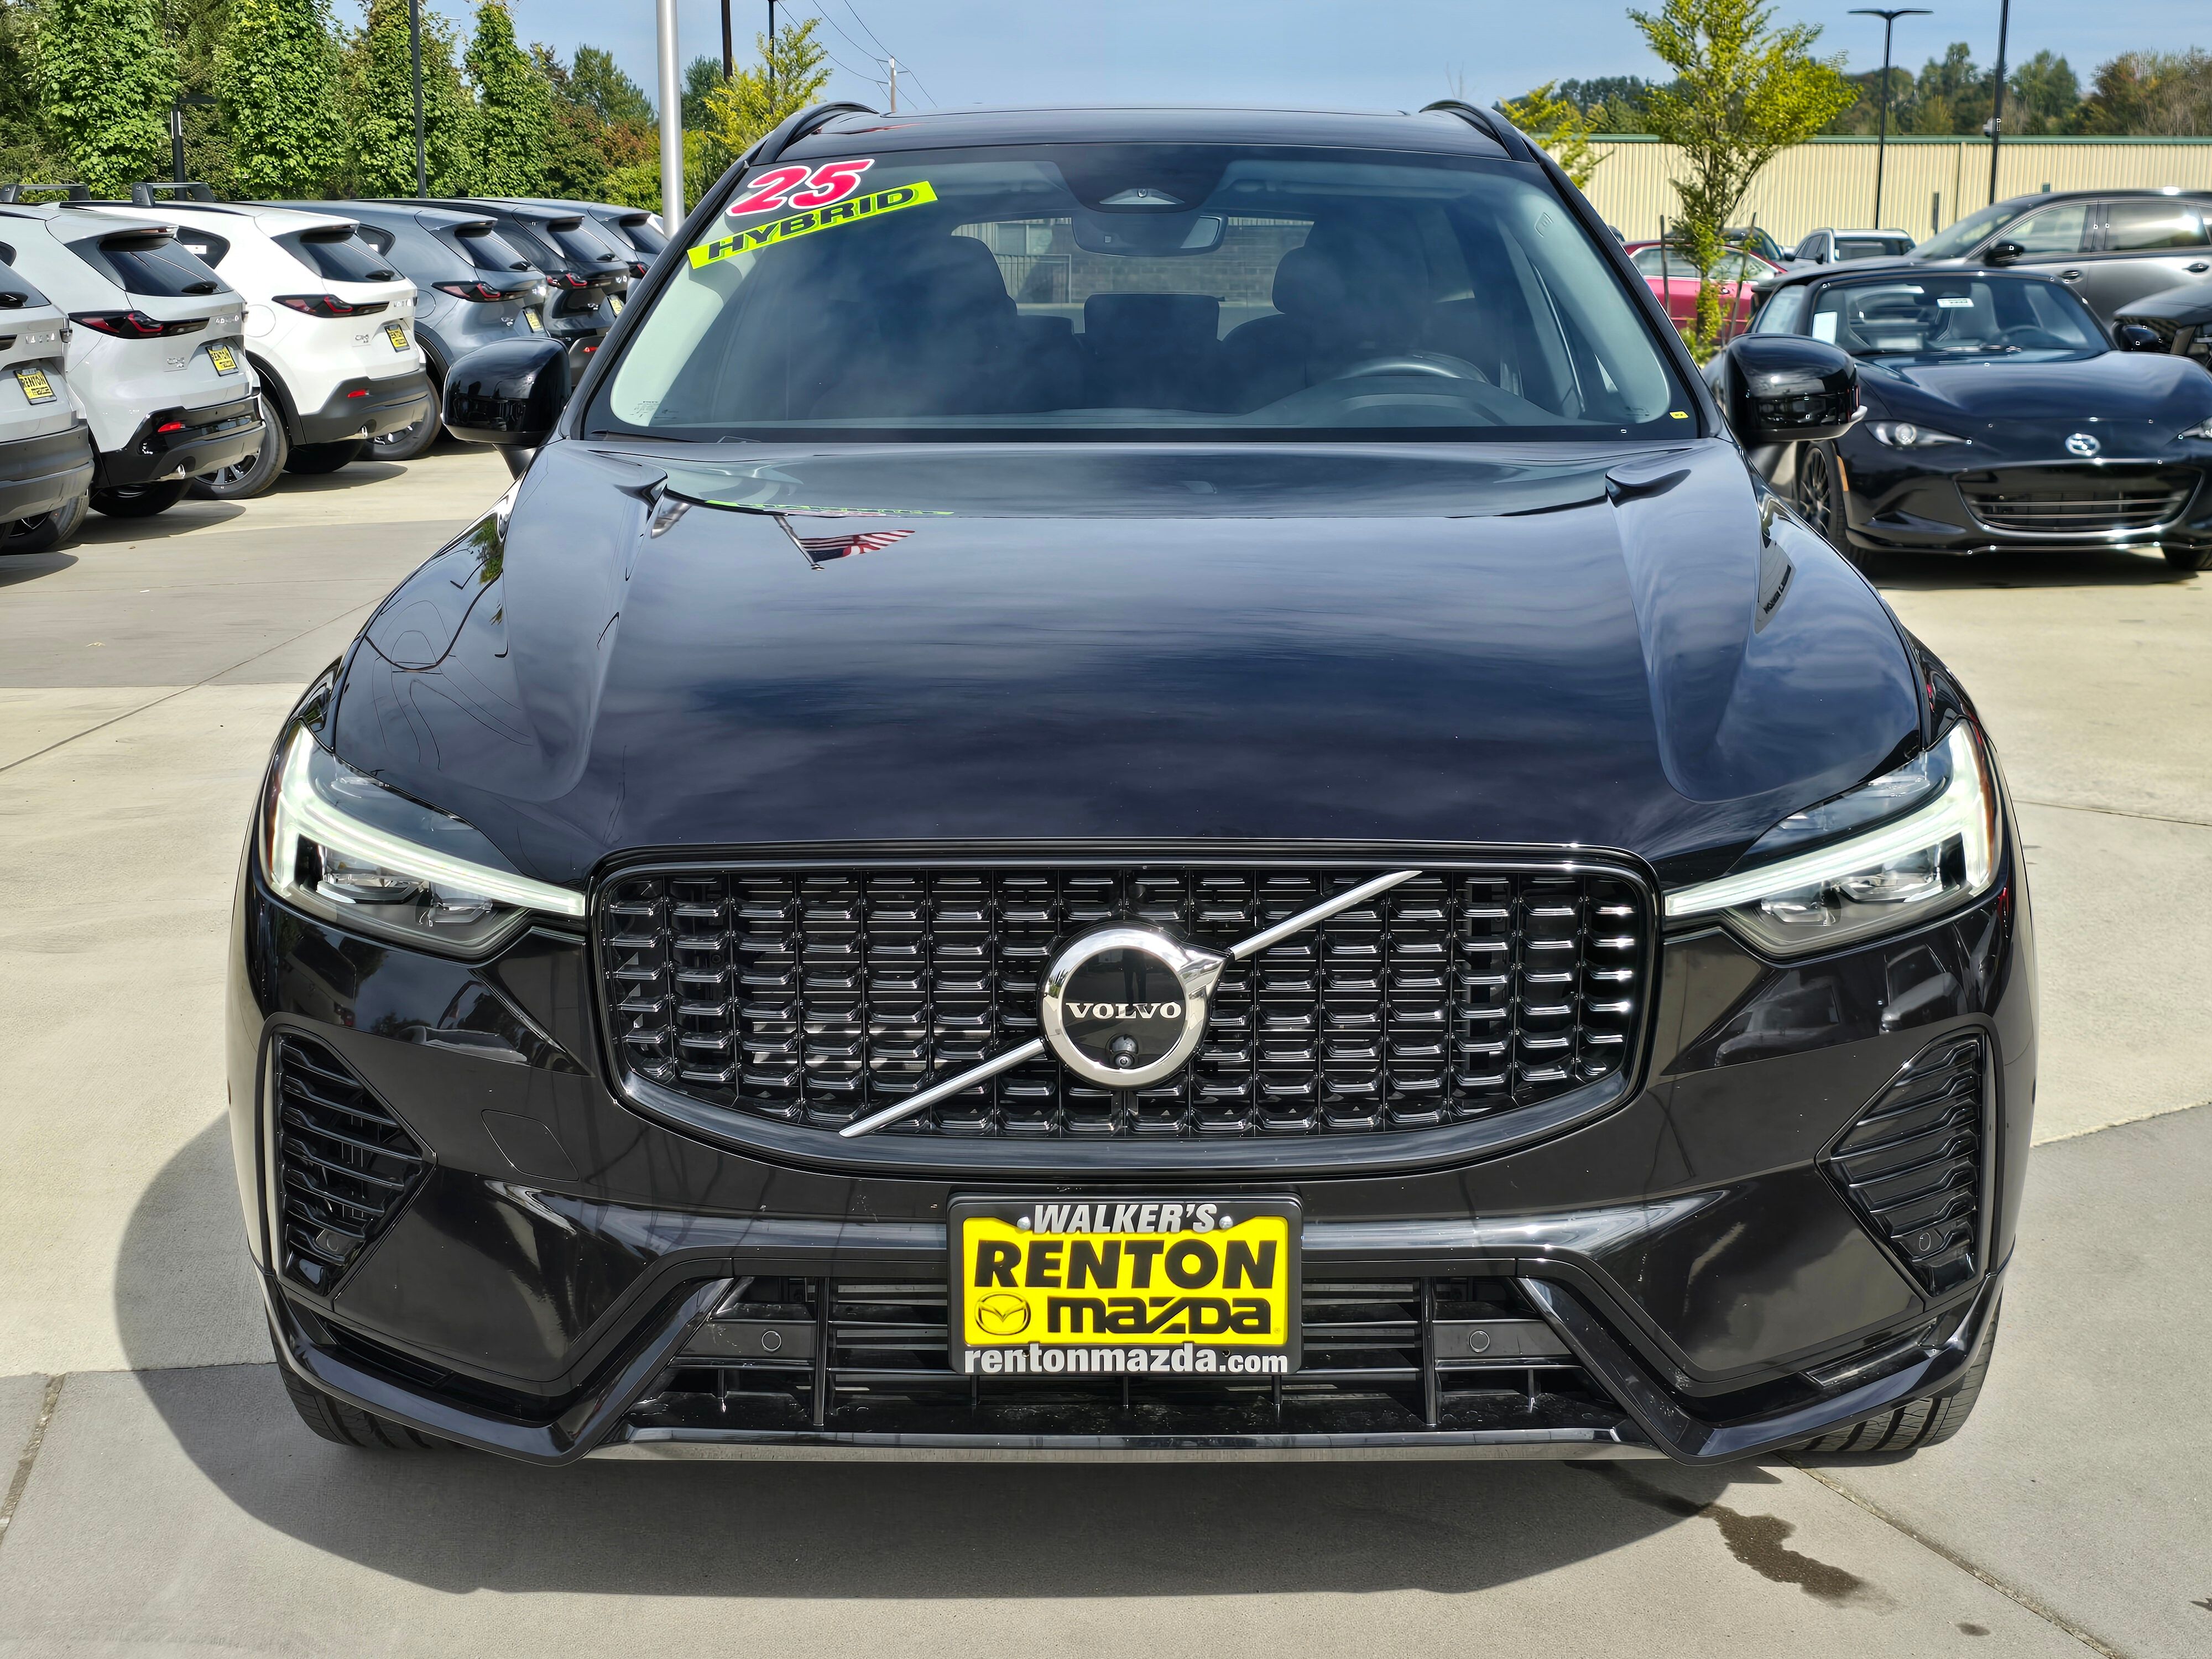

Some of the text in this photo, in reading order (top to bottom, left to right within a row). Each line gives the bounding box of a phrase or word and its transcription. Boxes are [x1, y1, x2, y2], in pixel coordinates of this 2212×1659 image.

[725, 159, 875, 216] 25
[708, 188, 919, 260] HYBRID
[1066, 1001, 1182, 1019] VOLVO
[1032, 1203, 1218, 1234] WALKER'S
[974, 1238, 1278, 1290] RENTON
[1047, 1296, 1271, 1334] mazda
[964, 1343, 1288, 1373] rentonmazda.com
